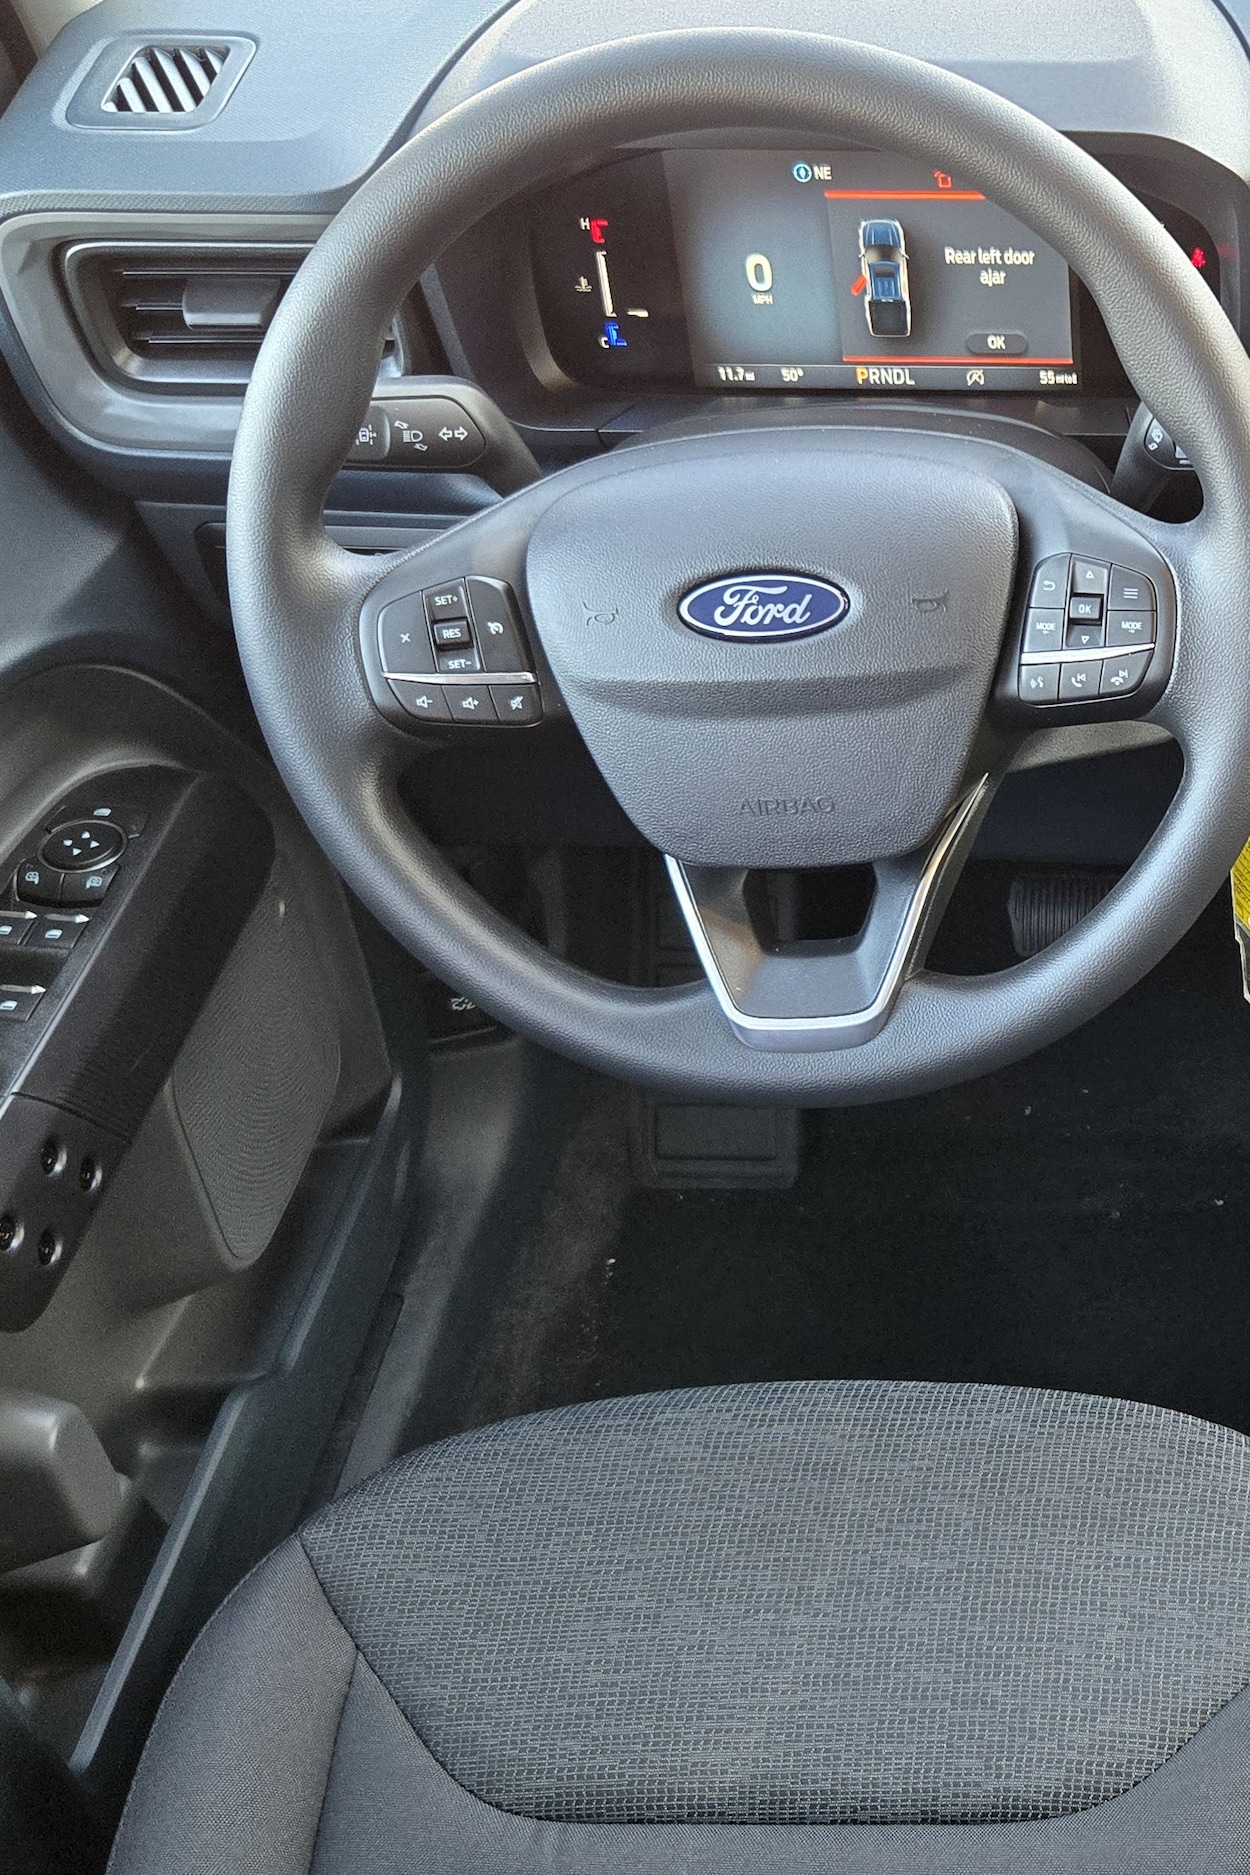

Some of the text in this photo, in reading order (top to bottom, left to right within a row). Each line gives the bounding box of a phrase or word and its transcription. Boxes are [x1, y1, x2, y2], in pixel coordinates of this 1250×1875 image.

[813, 164, 832, 180] NE
[580, 217, 590, 230] H
[944, 246, 1035, 265] Rear left door
[745, 253, 773, 291] 0
[980, 267, 1006, 287] ajar
[987, 335, 1005, 349] OK
[717, 366, 745, 381] 11.7
[780, 366, 804, 382] 50°
[856, 367, 916, 385] PRNDL
[714, 585, 812, 627] Ford
[1078, 603, 1092, 614] OK
[442, 628, 461, 639] RES
[1036, 622, 1056, 631] MODE
[1121, 621, 1142, 630] MODE
[740, 797, 835, 816] AIRBAG
